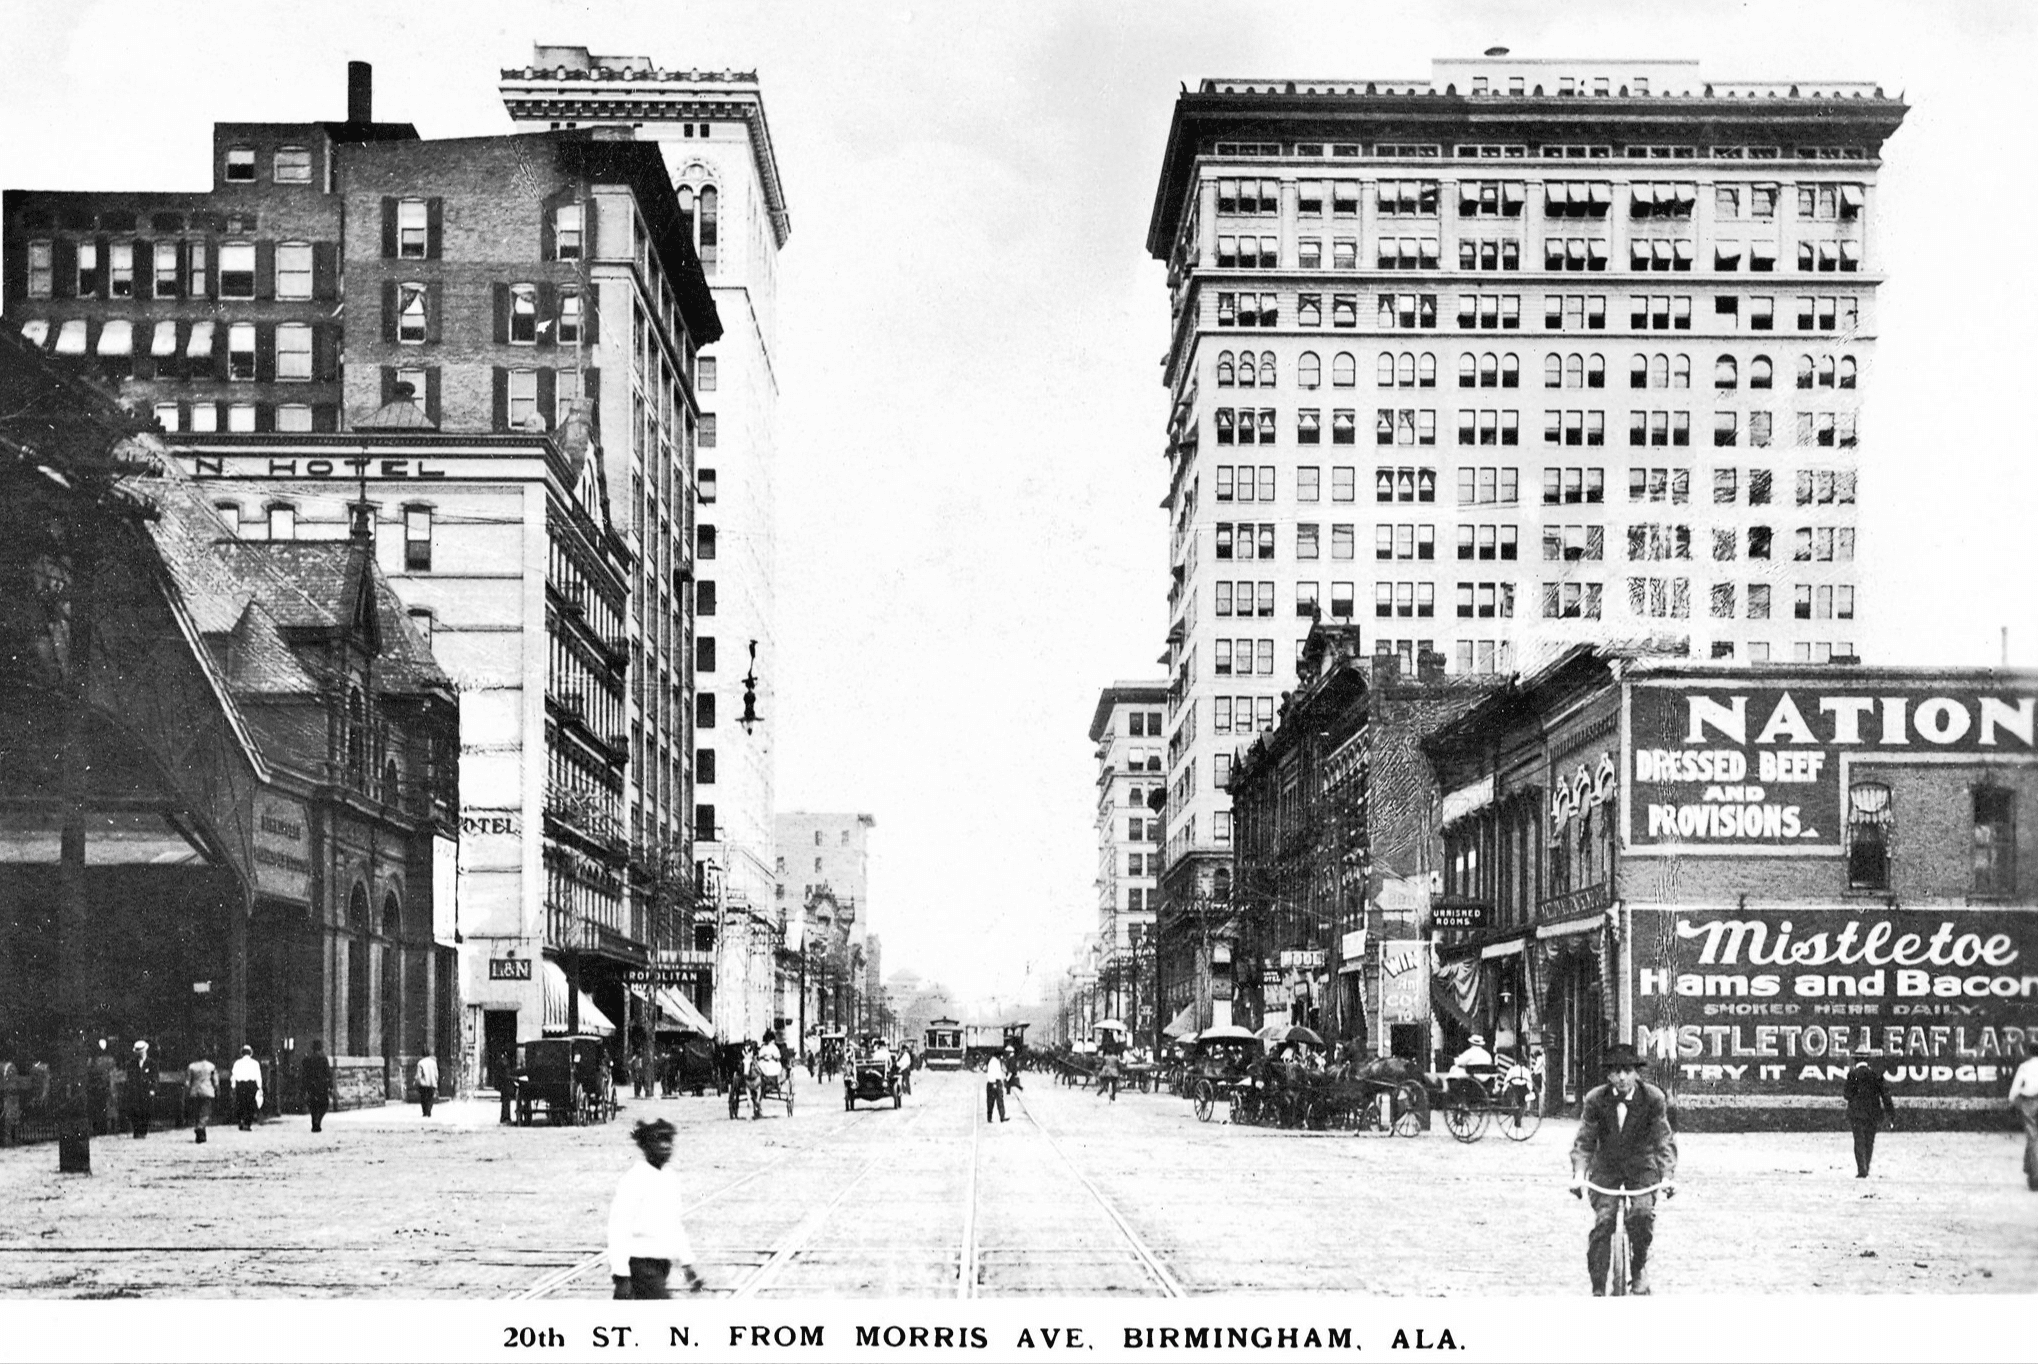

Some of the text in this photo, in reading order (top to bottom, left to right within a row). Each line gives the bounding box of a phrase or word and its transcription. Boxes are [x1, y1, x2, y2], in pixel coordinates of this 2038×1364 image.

[268, 459, 445, 477] HOTEL
[1685, 691, 2037, 746] NATION
[1636, 750, 1826, 783] DRESSED BEEF
[1702, 785, 1766, 803] AND
[461, 818, 518, 834] OTEL
[1436, 918, 1470, 926] ROOMS
[1677, 919, 2019, 968] Mistletoe
[491, 961, 530, 978] L&N
[1639, 967, 1781, 998] Hams
[1794, 967, 1885, 998] and
[1704, 1004, 1801, 1015] SMOKED
[1815, 1004, 1879, 1015] HERE
[1680, 1064, 1749, 1081] TRY
[1759, 1064, 1786, 1080] IT
[1798, 1064, 1851, 1081] AN
